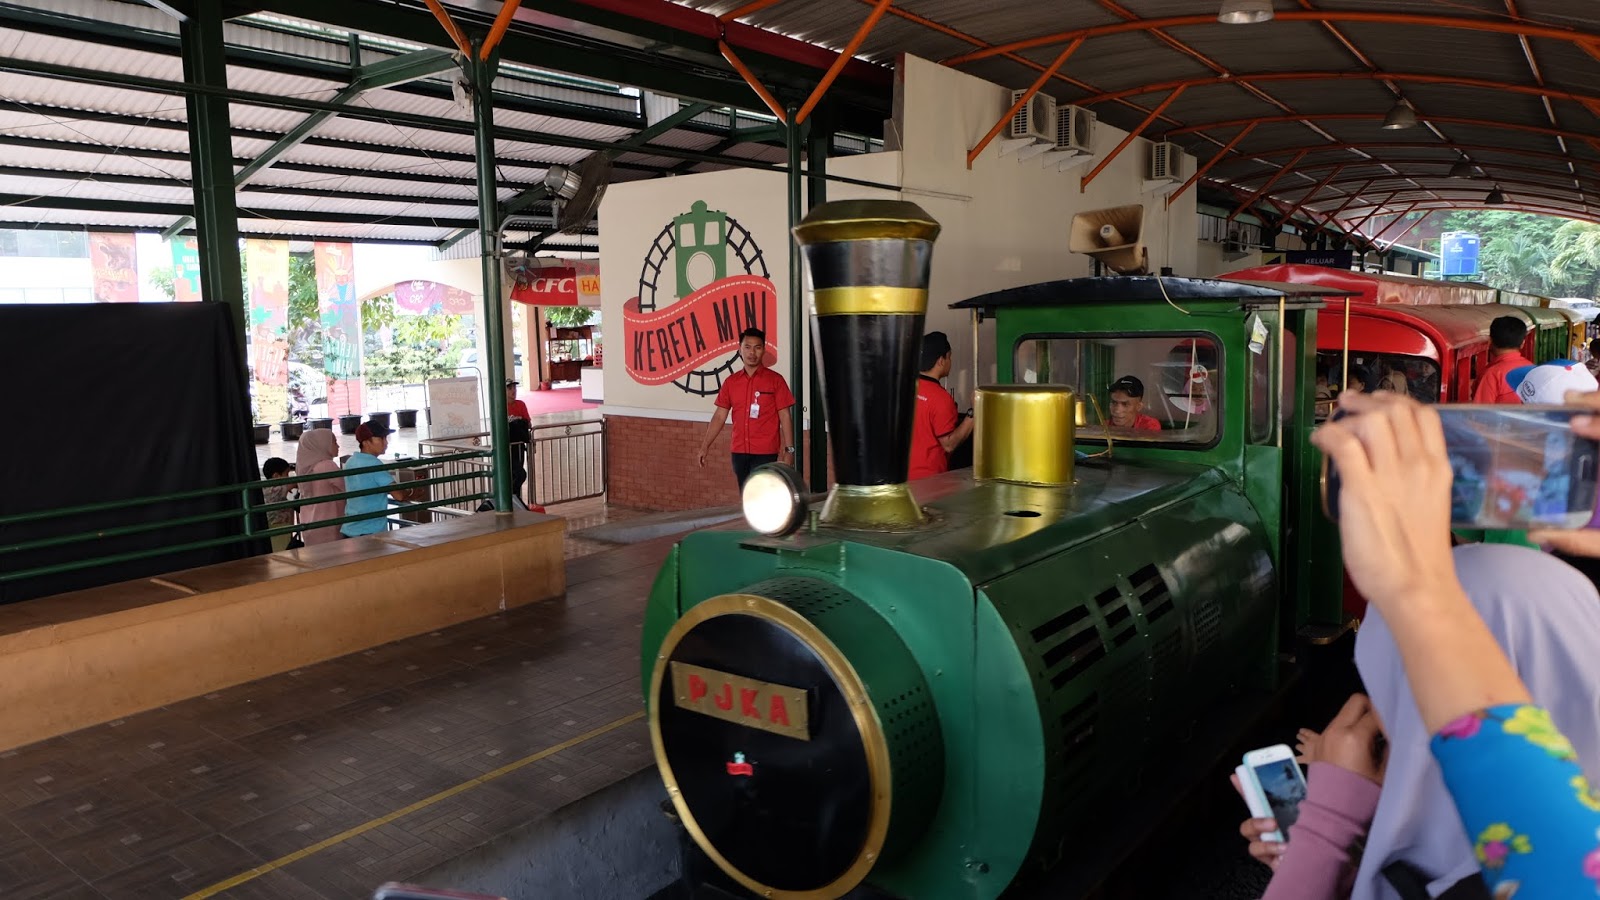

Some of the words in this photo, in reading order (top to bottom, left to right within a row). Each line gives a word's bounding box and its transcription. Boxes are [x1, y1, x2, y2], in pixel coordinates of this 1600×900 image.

[531, 278, 575, 293] CFC
[634, 311, 706, 372] KERETA
[713, 291, 767, 343] MINI
[688, 674, 791, 726] PJKA
